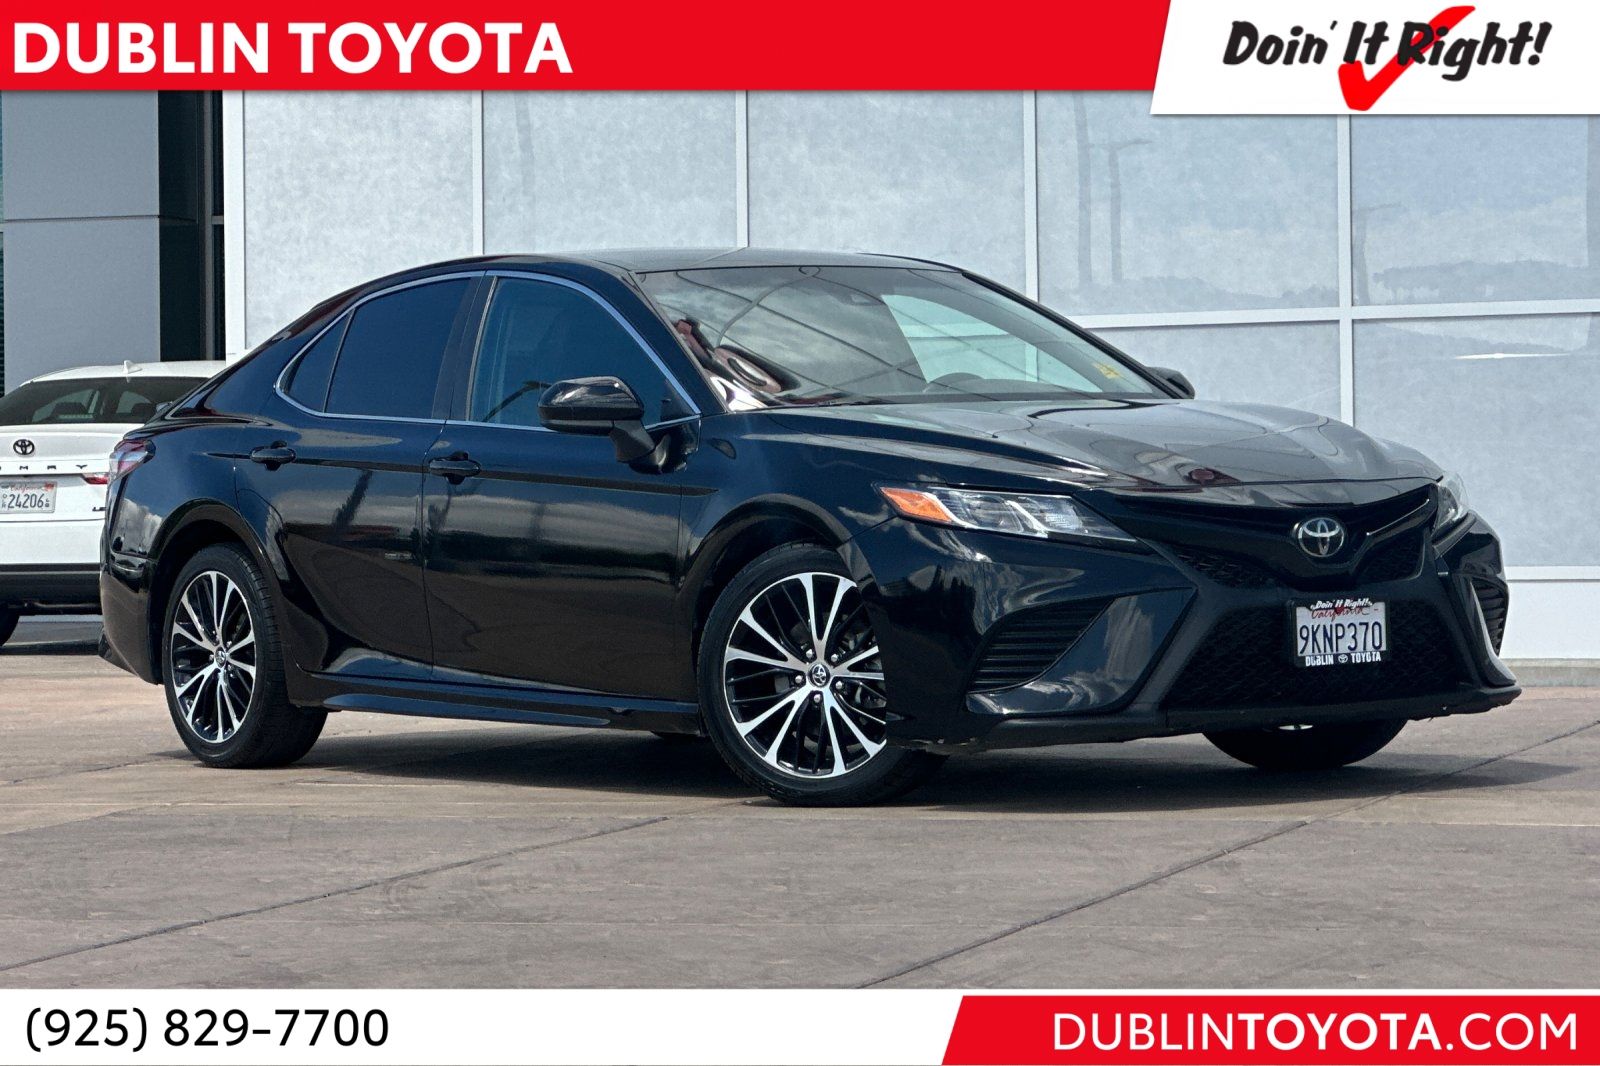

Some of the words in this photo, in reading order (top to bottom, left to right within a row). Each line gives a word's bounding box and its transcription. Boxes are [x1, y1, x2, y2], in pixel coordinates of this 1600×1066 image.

[8, 493, 45, 509] 24206
[1300, 621, 1383, 654] 9KNP370
[1305, 654, 1334, 666] DUBLIN
[1351, 651, 1381, 663] TOYOTA
